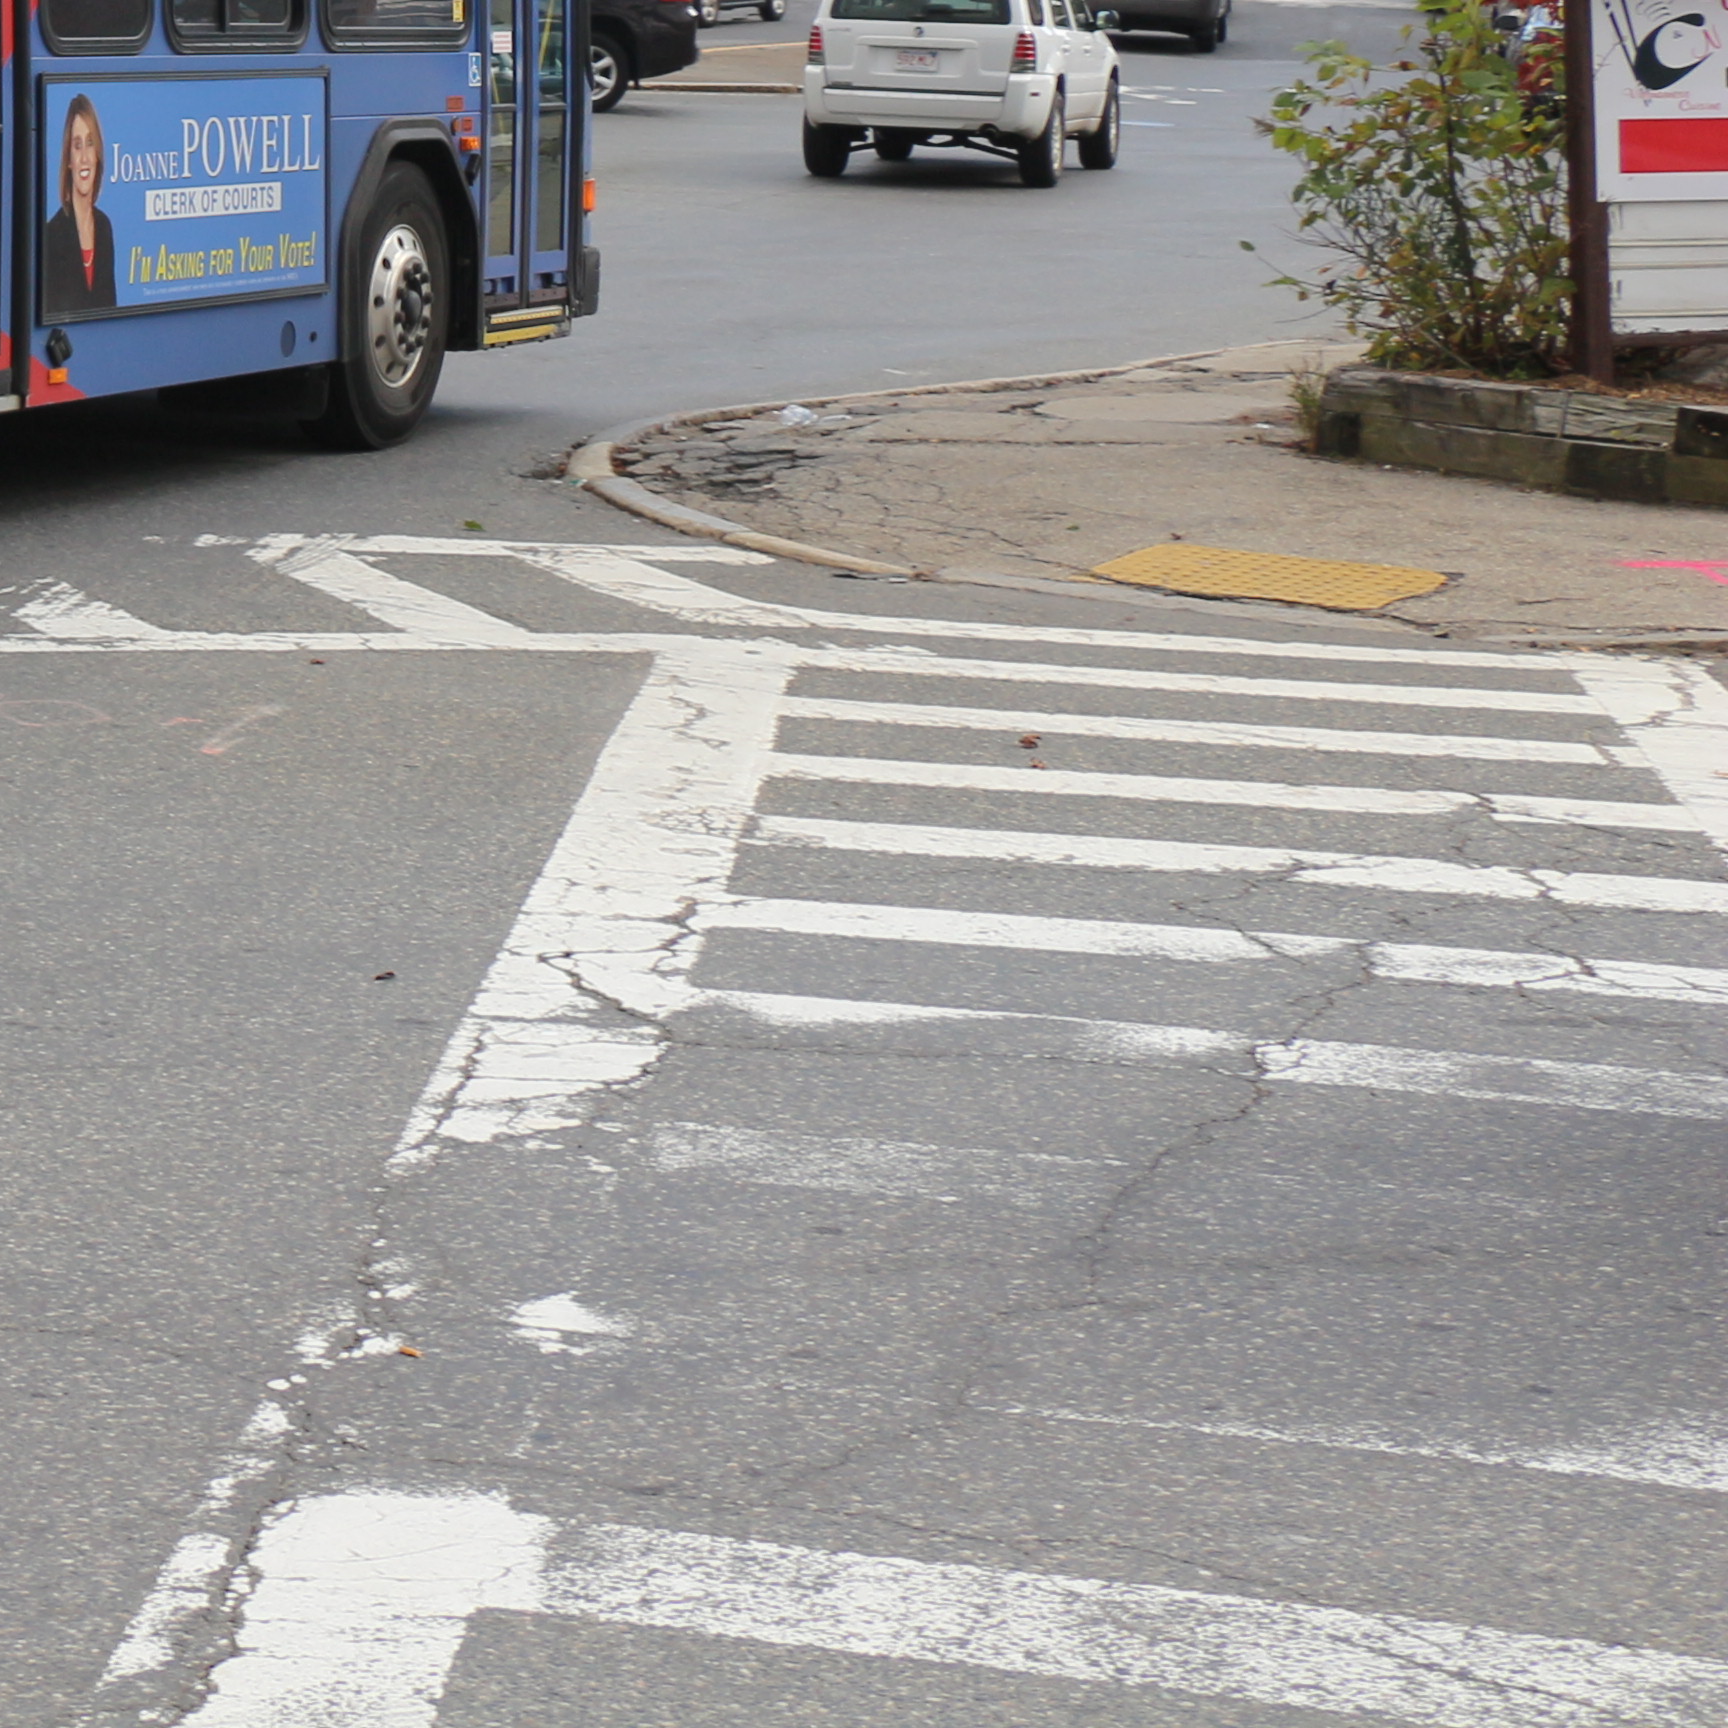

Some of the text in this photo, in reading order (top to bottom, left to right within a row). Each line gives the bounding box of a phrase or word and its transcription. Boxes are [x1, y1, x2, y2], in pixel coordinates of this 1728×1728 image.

[180, 114, 320, 178] POWELL
[153, 186, 275, 216] CLERK OF COURTS
